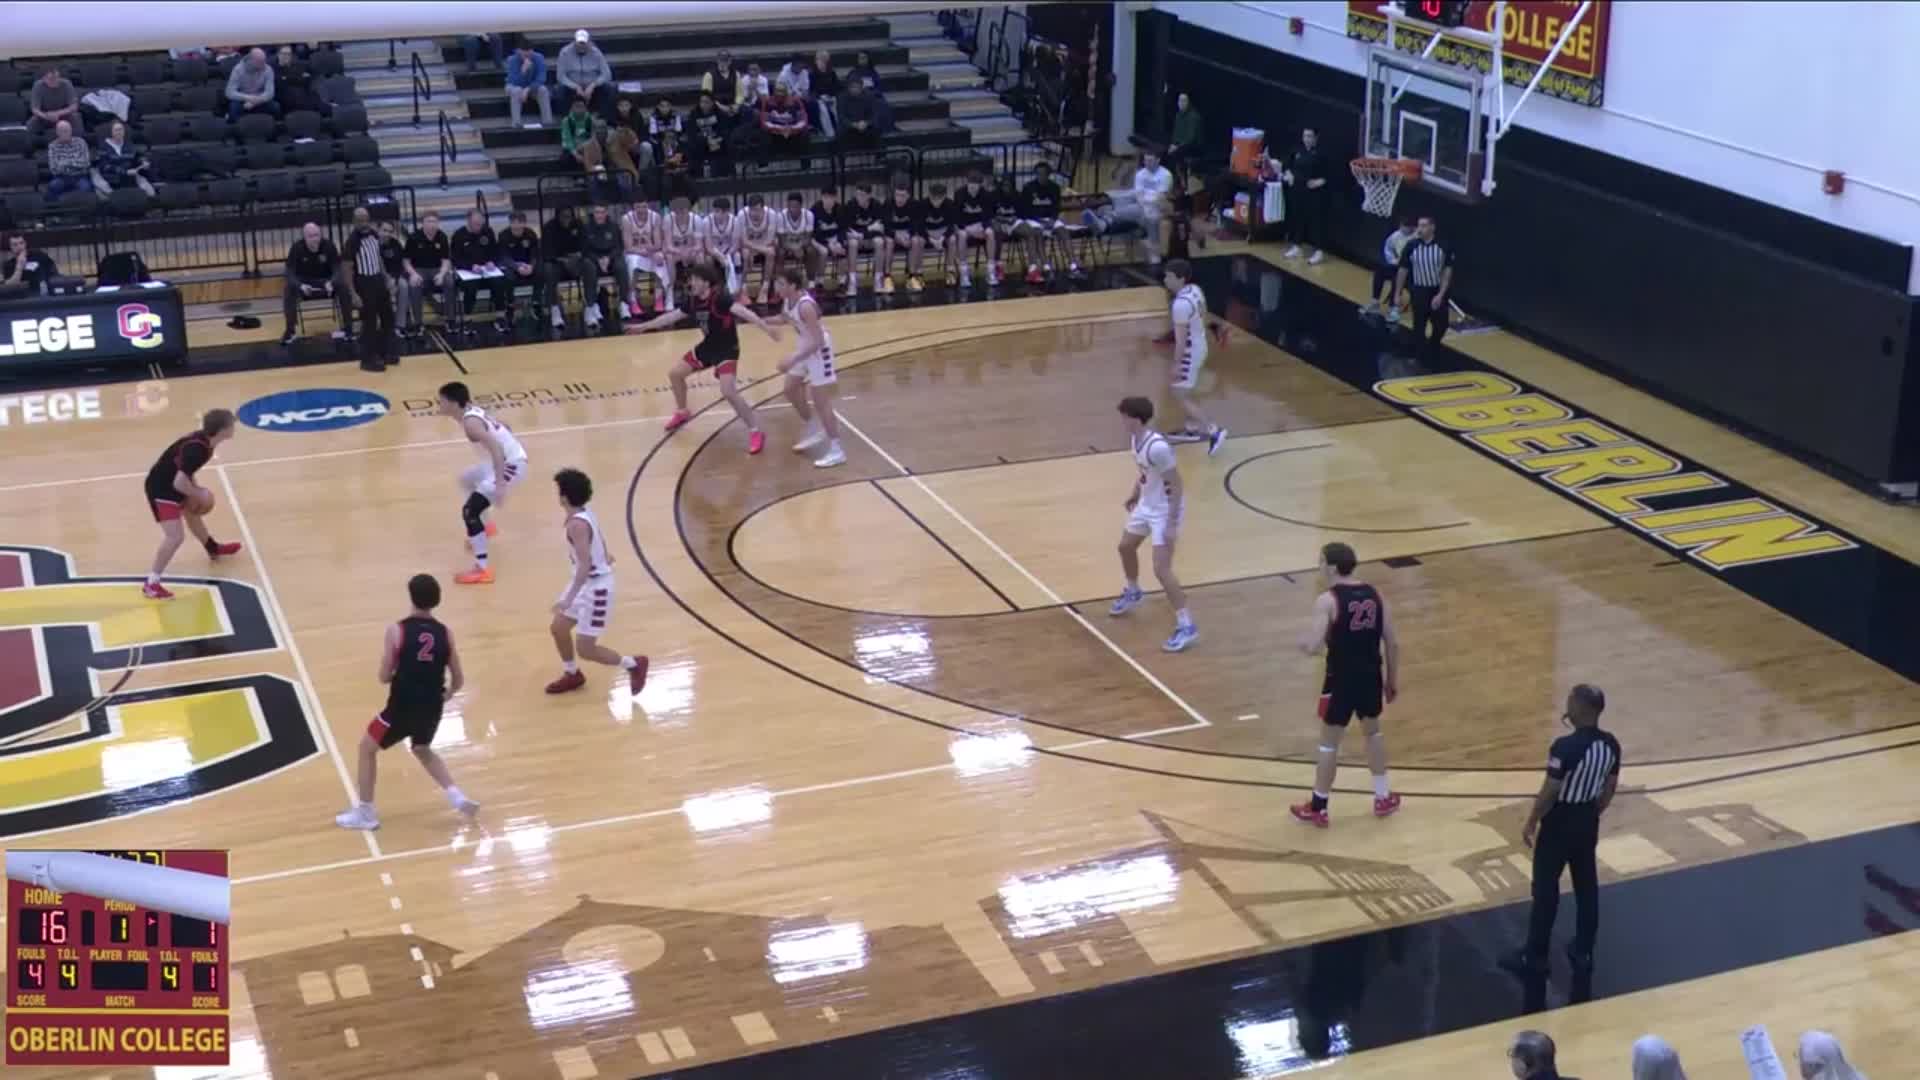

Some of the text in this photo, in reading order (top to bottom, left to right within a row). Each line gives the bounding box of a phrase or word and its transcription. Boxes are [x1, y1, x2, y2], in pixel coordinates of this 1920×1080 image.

[0, 314, 95, 355] EGE
[256, 402, 388, 427] NCAA
[1372, 371, 1859, 570] OBERLIN
[1348, 600, 1377, 631] 23
[417, 632, 434, 661] 2
